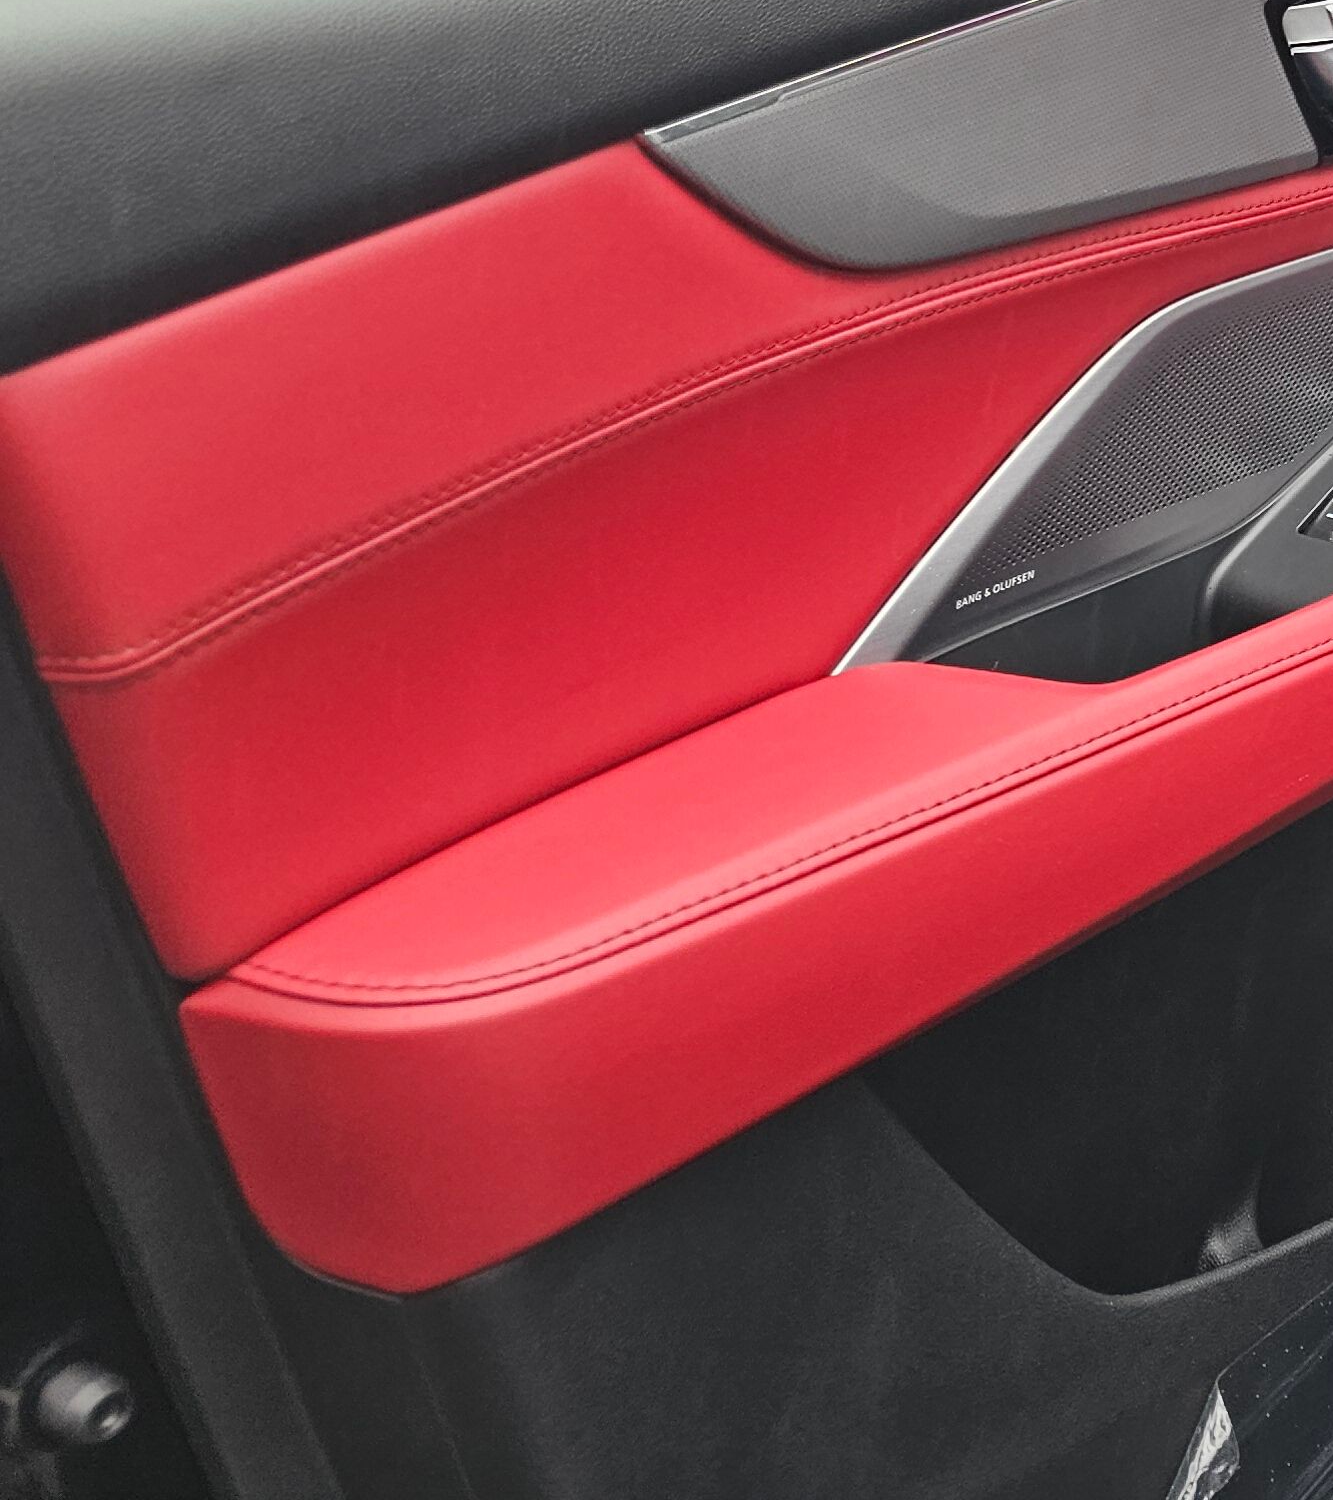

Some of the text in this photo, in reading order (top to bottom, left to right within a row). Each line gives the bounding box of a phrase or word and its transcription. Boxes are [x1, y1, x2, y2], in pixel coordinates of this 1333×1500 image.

[955, 569, 1036, 611] BANG & OLUFSEN
